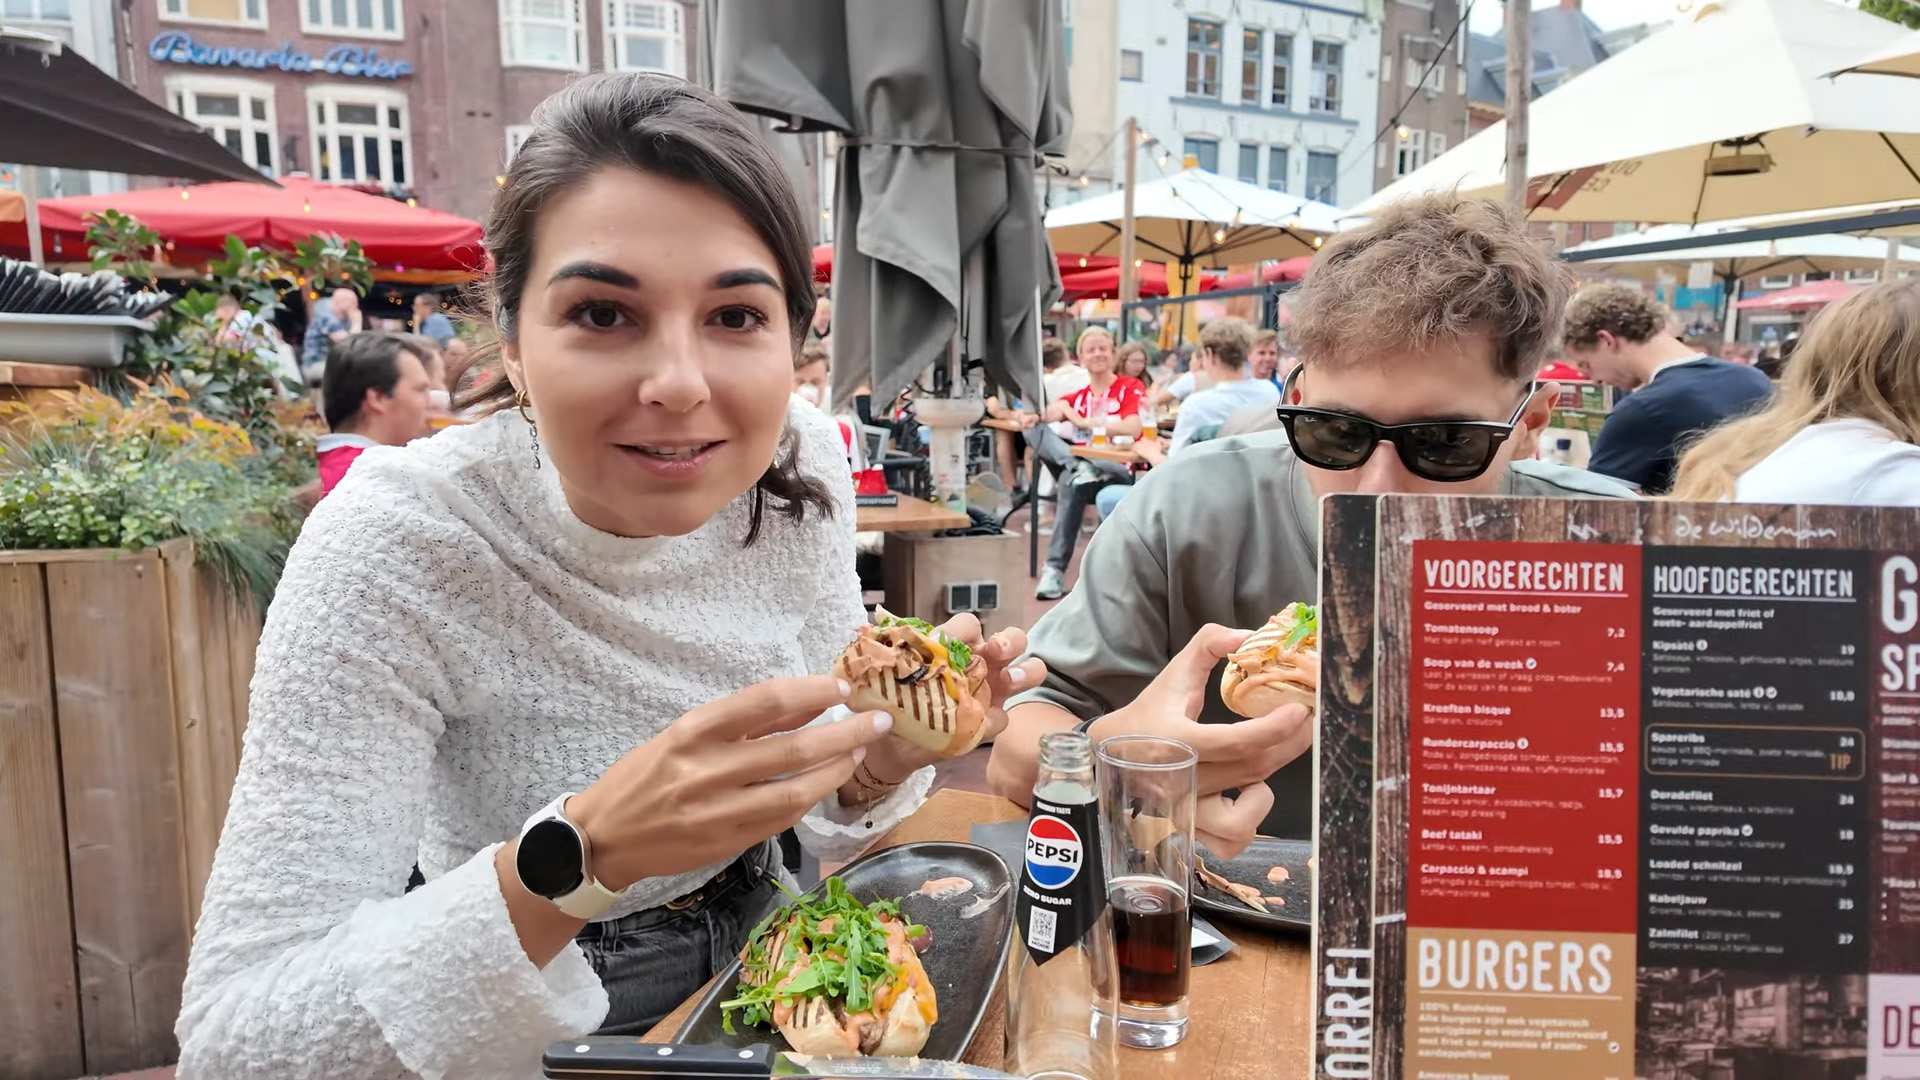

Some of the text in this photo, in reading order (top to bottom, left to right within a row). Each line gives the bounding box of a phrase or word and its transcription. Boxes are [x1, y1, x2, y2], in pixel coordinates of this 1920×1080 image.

[150, 30, 414, 79] Bavaria Bier
[1424, 559, 1624, 591] VOORGERECHTEN
[1654, 565, 1853, 597] HOOFDGERECHTEN
[1424, 601, 1484, 612] Geserveerd
[1487, 603, 1507, 613] met
[1509, 603, 1540, 613] brood
[1554, 604, 1582, 614] boter
[1653, 606, 1775, 619] Geserveerd met friet of
[1424, 623, 1499, 636] Tomatensoep
[1653, 619, 1763, 630] zoete- aardappelfriet
[1607, 627, 1625, 639] 7,2
[1423, 657, 1524, 669] Soep van de week
[1606, 662, 1625, 672] 7,4
[1652, 686, 1751, 699] Vegetarische saté
[1423, 703, 1511, 716] Kreeften bisque
[1422, 737, 1515, 749] Rundercarpaccio
[1651, 732, 1705, 744] Spareribs
[1830, 753, 1851, 770] TIP
[1422, 782, 1496, 795] Tonijntartaar
[1650, 789, 1713, 801] Doradefilet
[1421, 829, 1483, 840] Beef tataki
[1650, 824, 1740, 837] Gevulde paprika
[1027, 838, 1078, 863] PEPSI
[1421, 863, 1475, 875] Carpaccio
[1489, 866, 1529, 877] scampi
[1649, 859, 1742, 871] Loaded schnitzel
[1041, 896, 1072, 905] SUGAR
[1649, 893, 1708, 905] Kabeljauw
[1649, 928, 1699, 939] Zalmfilet
[1418, 938, 1612, 993] BURGERS
[1418, 1014, 1438, 1023] Alle
[1441, 1015, 1481, 1026] burgers
